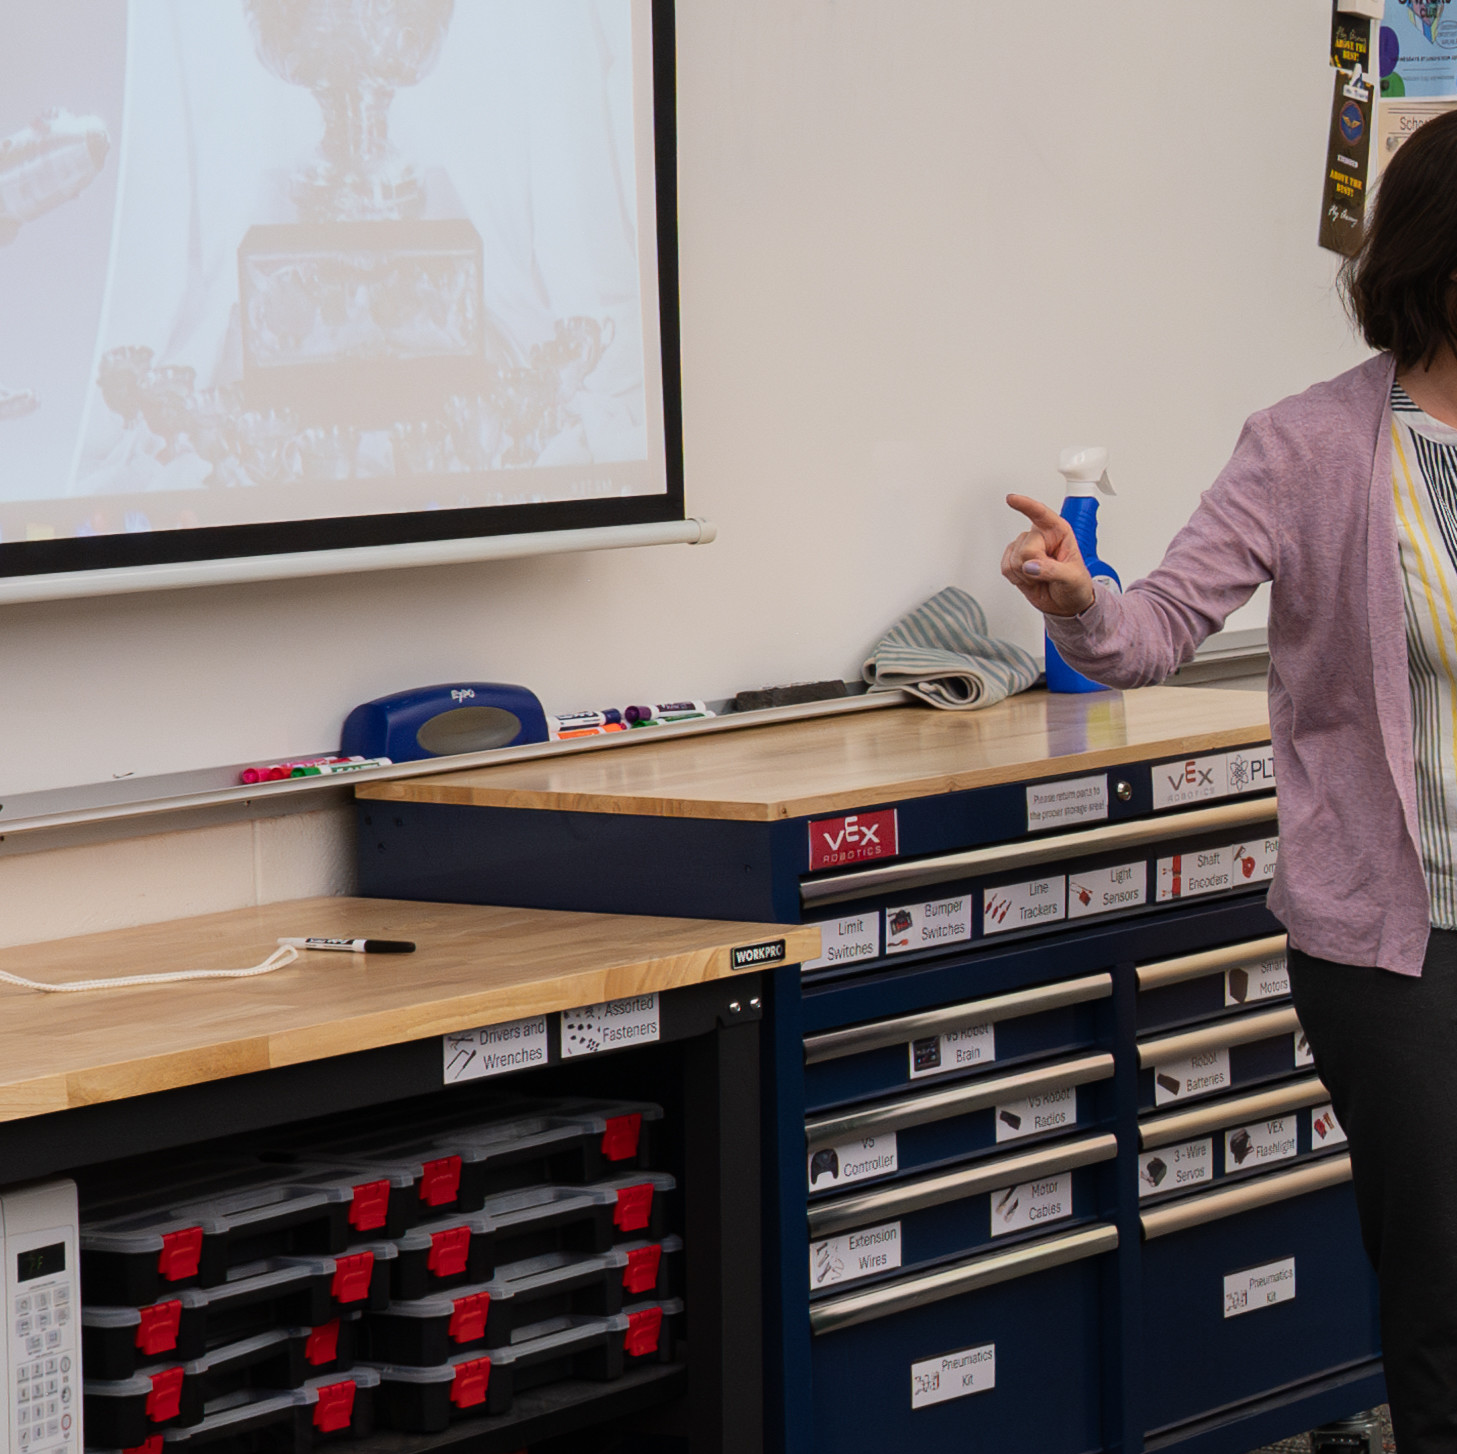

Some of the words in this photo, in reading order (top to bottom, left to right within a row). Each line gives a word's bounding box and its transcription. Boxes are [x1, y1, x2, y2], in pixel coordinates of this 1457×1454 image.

[1168, 761, 1213, 791] VEX
[1251, 757, 1276, 780] PLT
[1033, 794, 1055, 804] Please
[1056, 791, 1075, 801] return
[1076, 788, 1092, 799] parts
[1093, 786, 1100, 796] to
[1167, 787, 1215, 802] ROBOTICS
[1030, 811, 1041, 820] the
[1041, 808, 1063, 821] proper
[1064, 804, 1087, 816] storage
[823, 816, 880, 850] VEX
[823, 845, 882, 863] ROBOTICS
[1265, 840, 1279, 854] Pot
[1197, 853, 1220, 868] Shaft
[1111, 867, 1132, 884] Light
[1189, 874, 1229, 891] Encoders
[1029, 882, 1049, 896] Line
[1103, 889, 1139, 906] Sensors
[924, 900, 963, 918] Bumper
[1020, 902, 1058, 920] Trackers
[838, 919, 864, 936] Limit
[921, 922, 965, 941] Switches
[736, 944, 783, 963] WORKPRO
[827, 942, 873, 961] Switches
[1260, 957, 1287, 974] Smart
[1260, 979, 1288, 995] Motors
[604, 996, 654, 1018] Assorted
[479, 1023, 521, 1046] Drivers
[523, 1020, 545, 1038] and
[602, 1020, 657, 1043] Fasteners
[483, 1046, 543, 1070] Wrenches
[956, 1047, 980, 1064] Brain
[1186, 1072, 1225, 1092] Batteries
[1034, 1111, 1066, 1129] Radios
[1266, 1120, 1284, 1135] VEX
[1256, 1138, 1295, 1158] Flashlight
[844, 1154, 894, 1177] Controller
[1176, 1165, 1205, 1183] Servos
[1031, 1180, 1058, 1199] Motor
[1029, 1202, 1061, 1221] Cables
[849, 1228, 897, 1251] Extension
[858, 1253, 887, 1269] Wires
[1249, 1268, 1293, 1290] Pneumatics
[1266, 1291, 1277, 1303] Kit
[941, 1349, 993, 1371] Pneumatics
[962, 1374, 974, 1386] Kit
